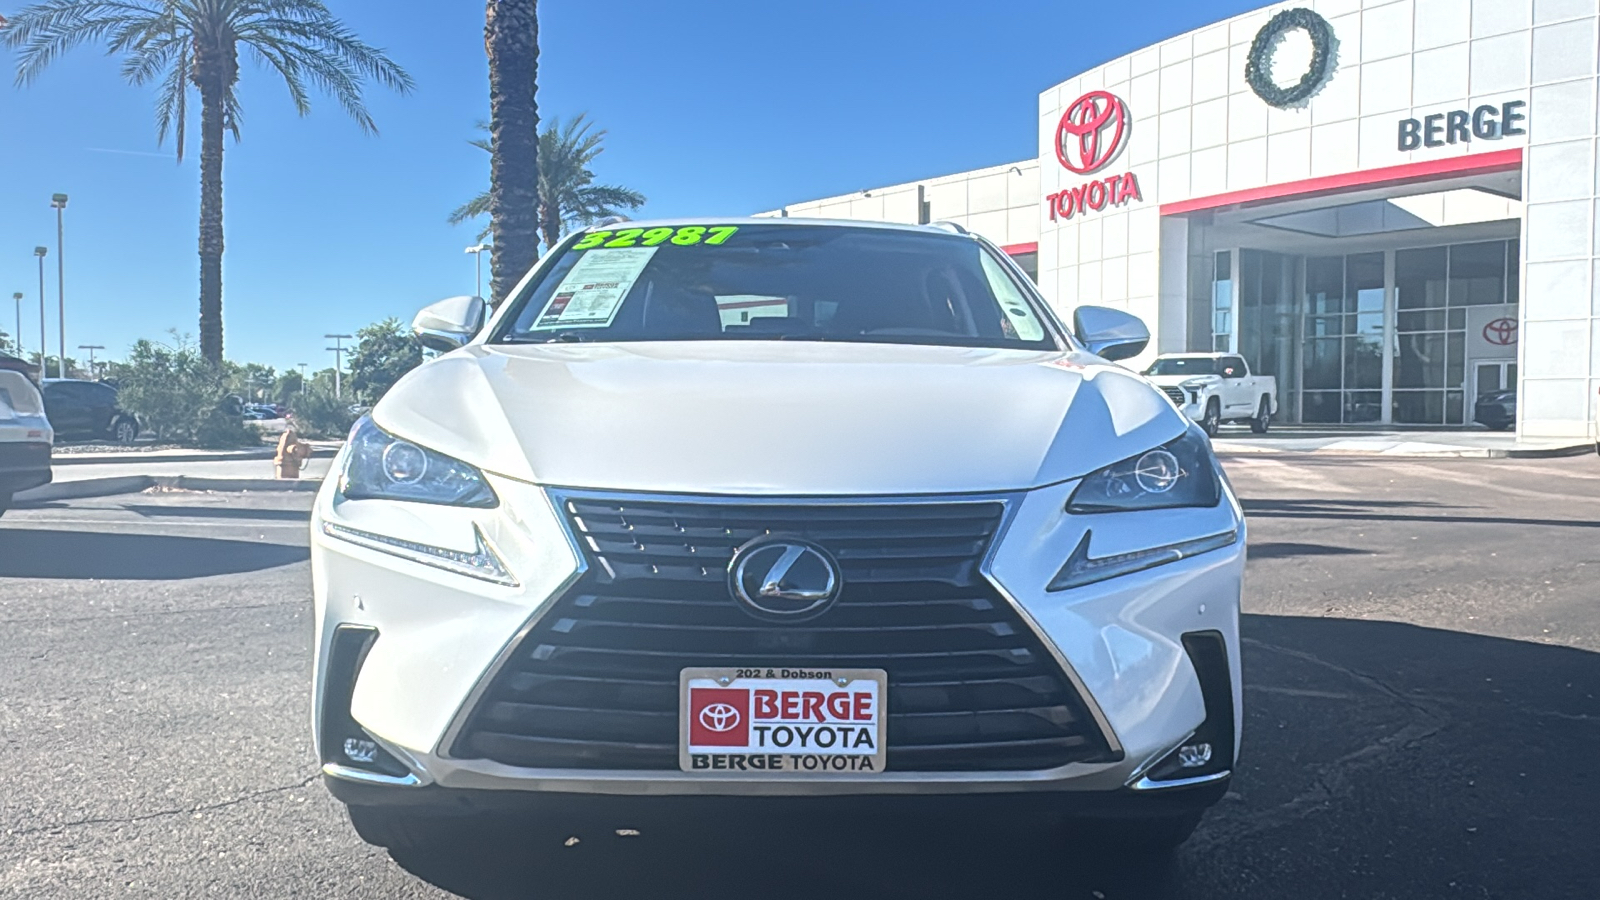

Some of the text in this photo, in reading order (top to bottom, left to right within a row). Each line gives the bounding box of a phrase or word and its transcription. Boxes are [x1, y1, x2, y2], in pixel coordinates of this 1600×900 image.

[1398, 100, 1526, 151] BERGE
[1046, 172, 1142, 222] TOYOTA
[572, 226, 738, 250] 32987
[736, 669, 832, 679] 202 & Dobson
[753, 689, 873, 723] BERGE
[753, 726, 875, 749] TOYOTA
[691, 754, 784, 770] BERGE
[790, 754, 874, 771] TOYOTA
